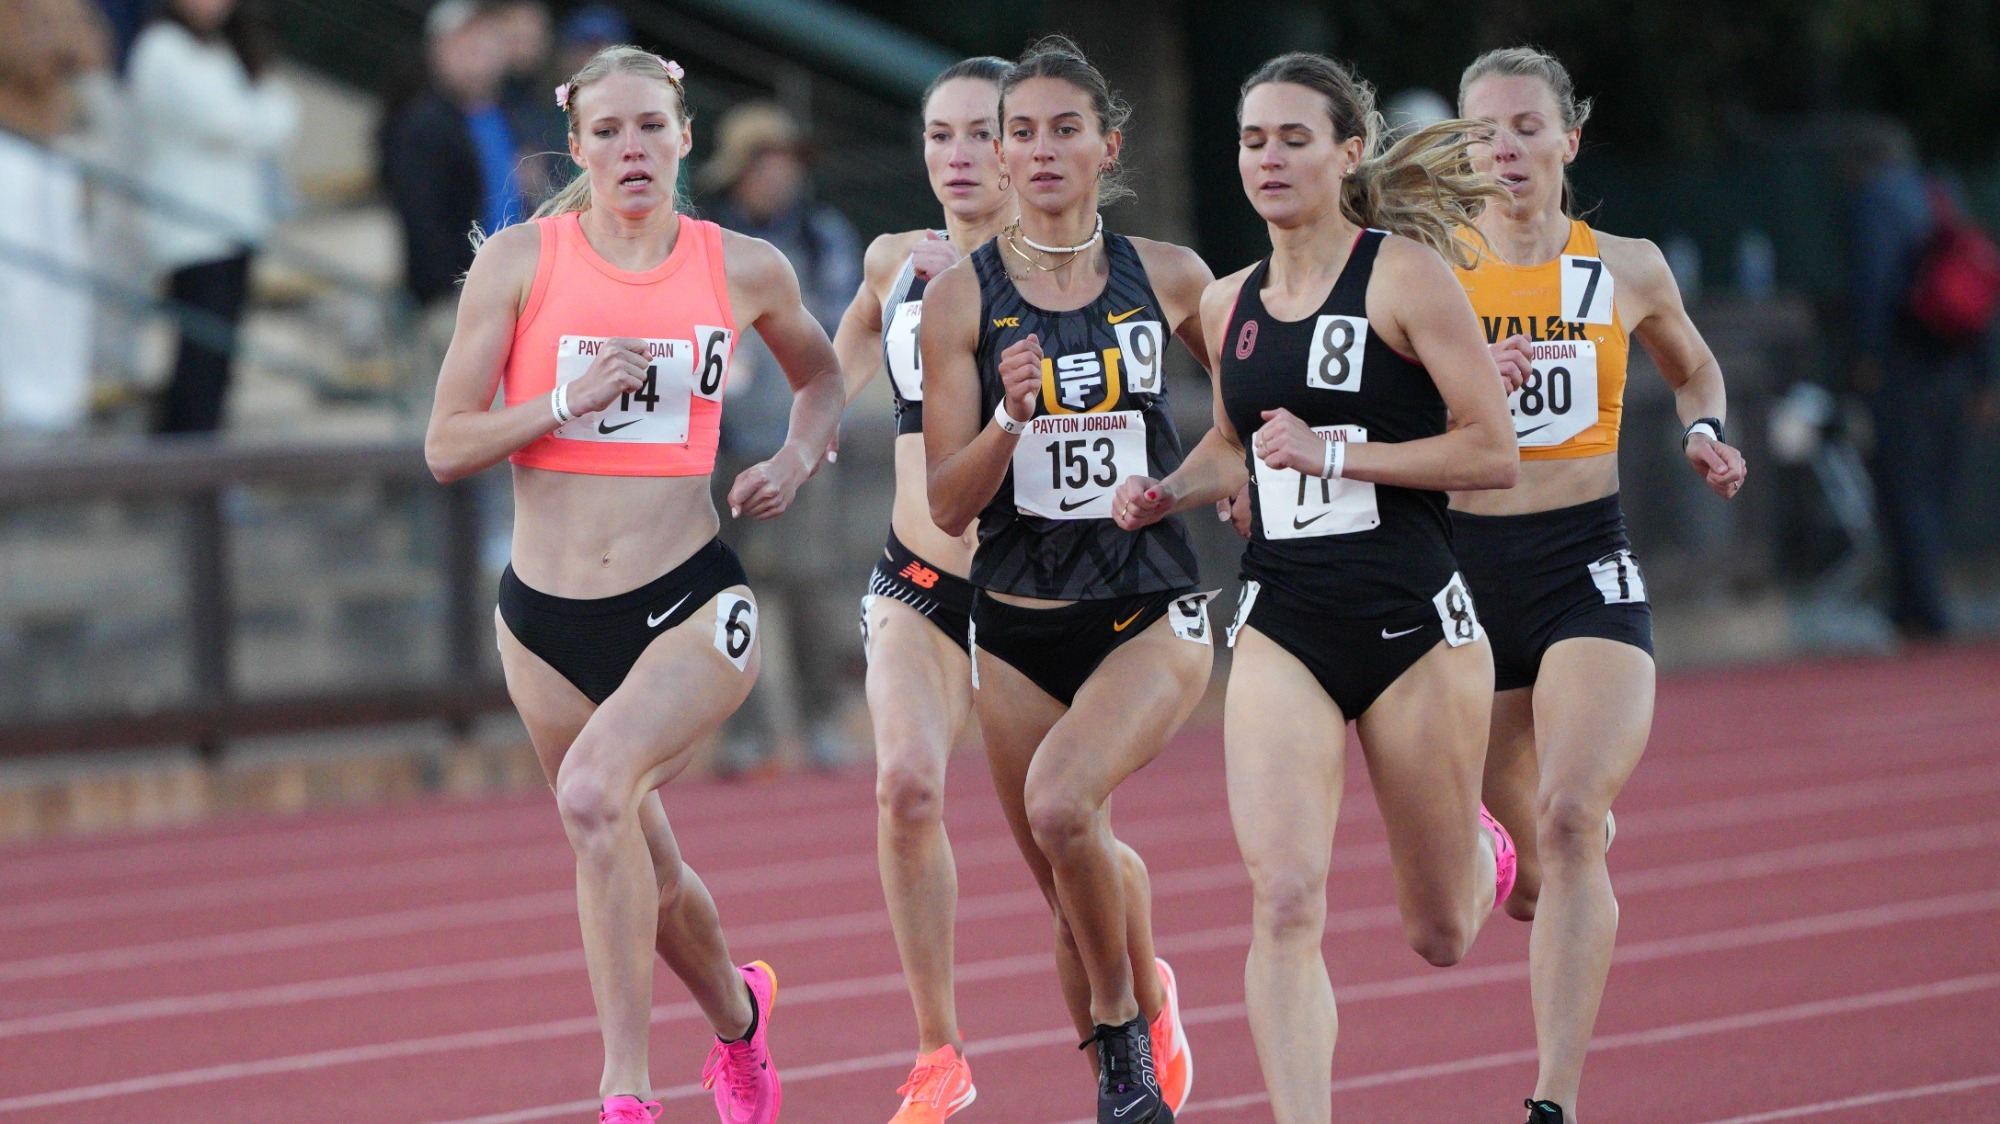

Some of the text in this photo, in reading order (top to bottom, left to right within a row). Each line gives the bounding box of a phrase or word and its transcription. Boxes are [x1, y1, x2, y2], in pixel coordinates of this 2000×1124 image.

[1571, 259, 1602, 319] 7
[578, 340, 674, 358] PAY DAN
[700, 330, 725, 395] 6
[1129, 325, 1157, 390] 9
[1319, 319, 1355, 385] 8
[1510, 366, 1572, 416] 80
[1033, 414, 1127, 434] PAYTON JORDAN
[1313, 429, 1348, 443] RDAN
[1046, 437, 1118, 489] 153
[725, 600, 751, 659] 6
[1446, 584, 1474, 640] 8
